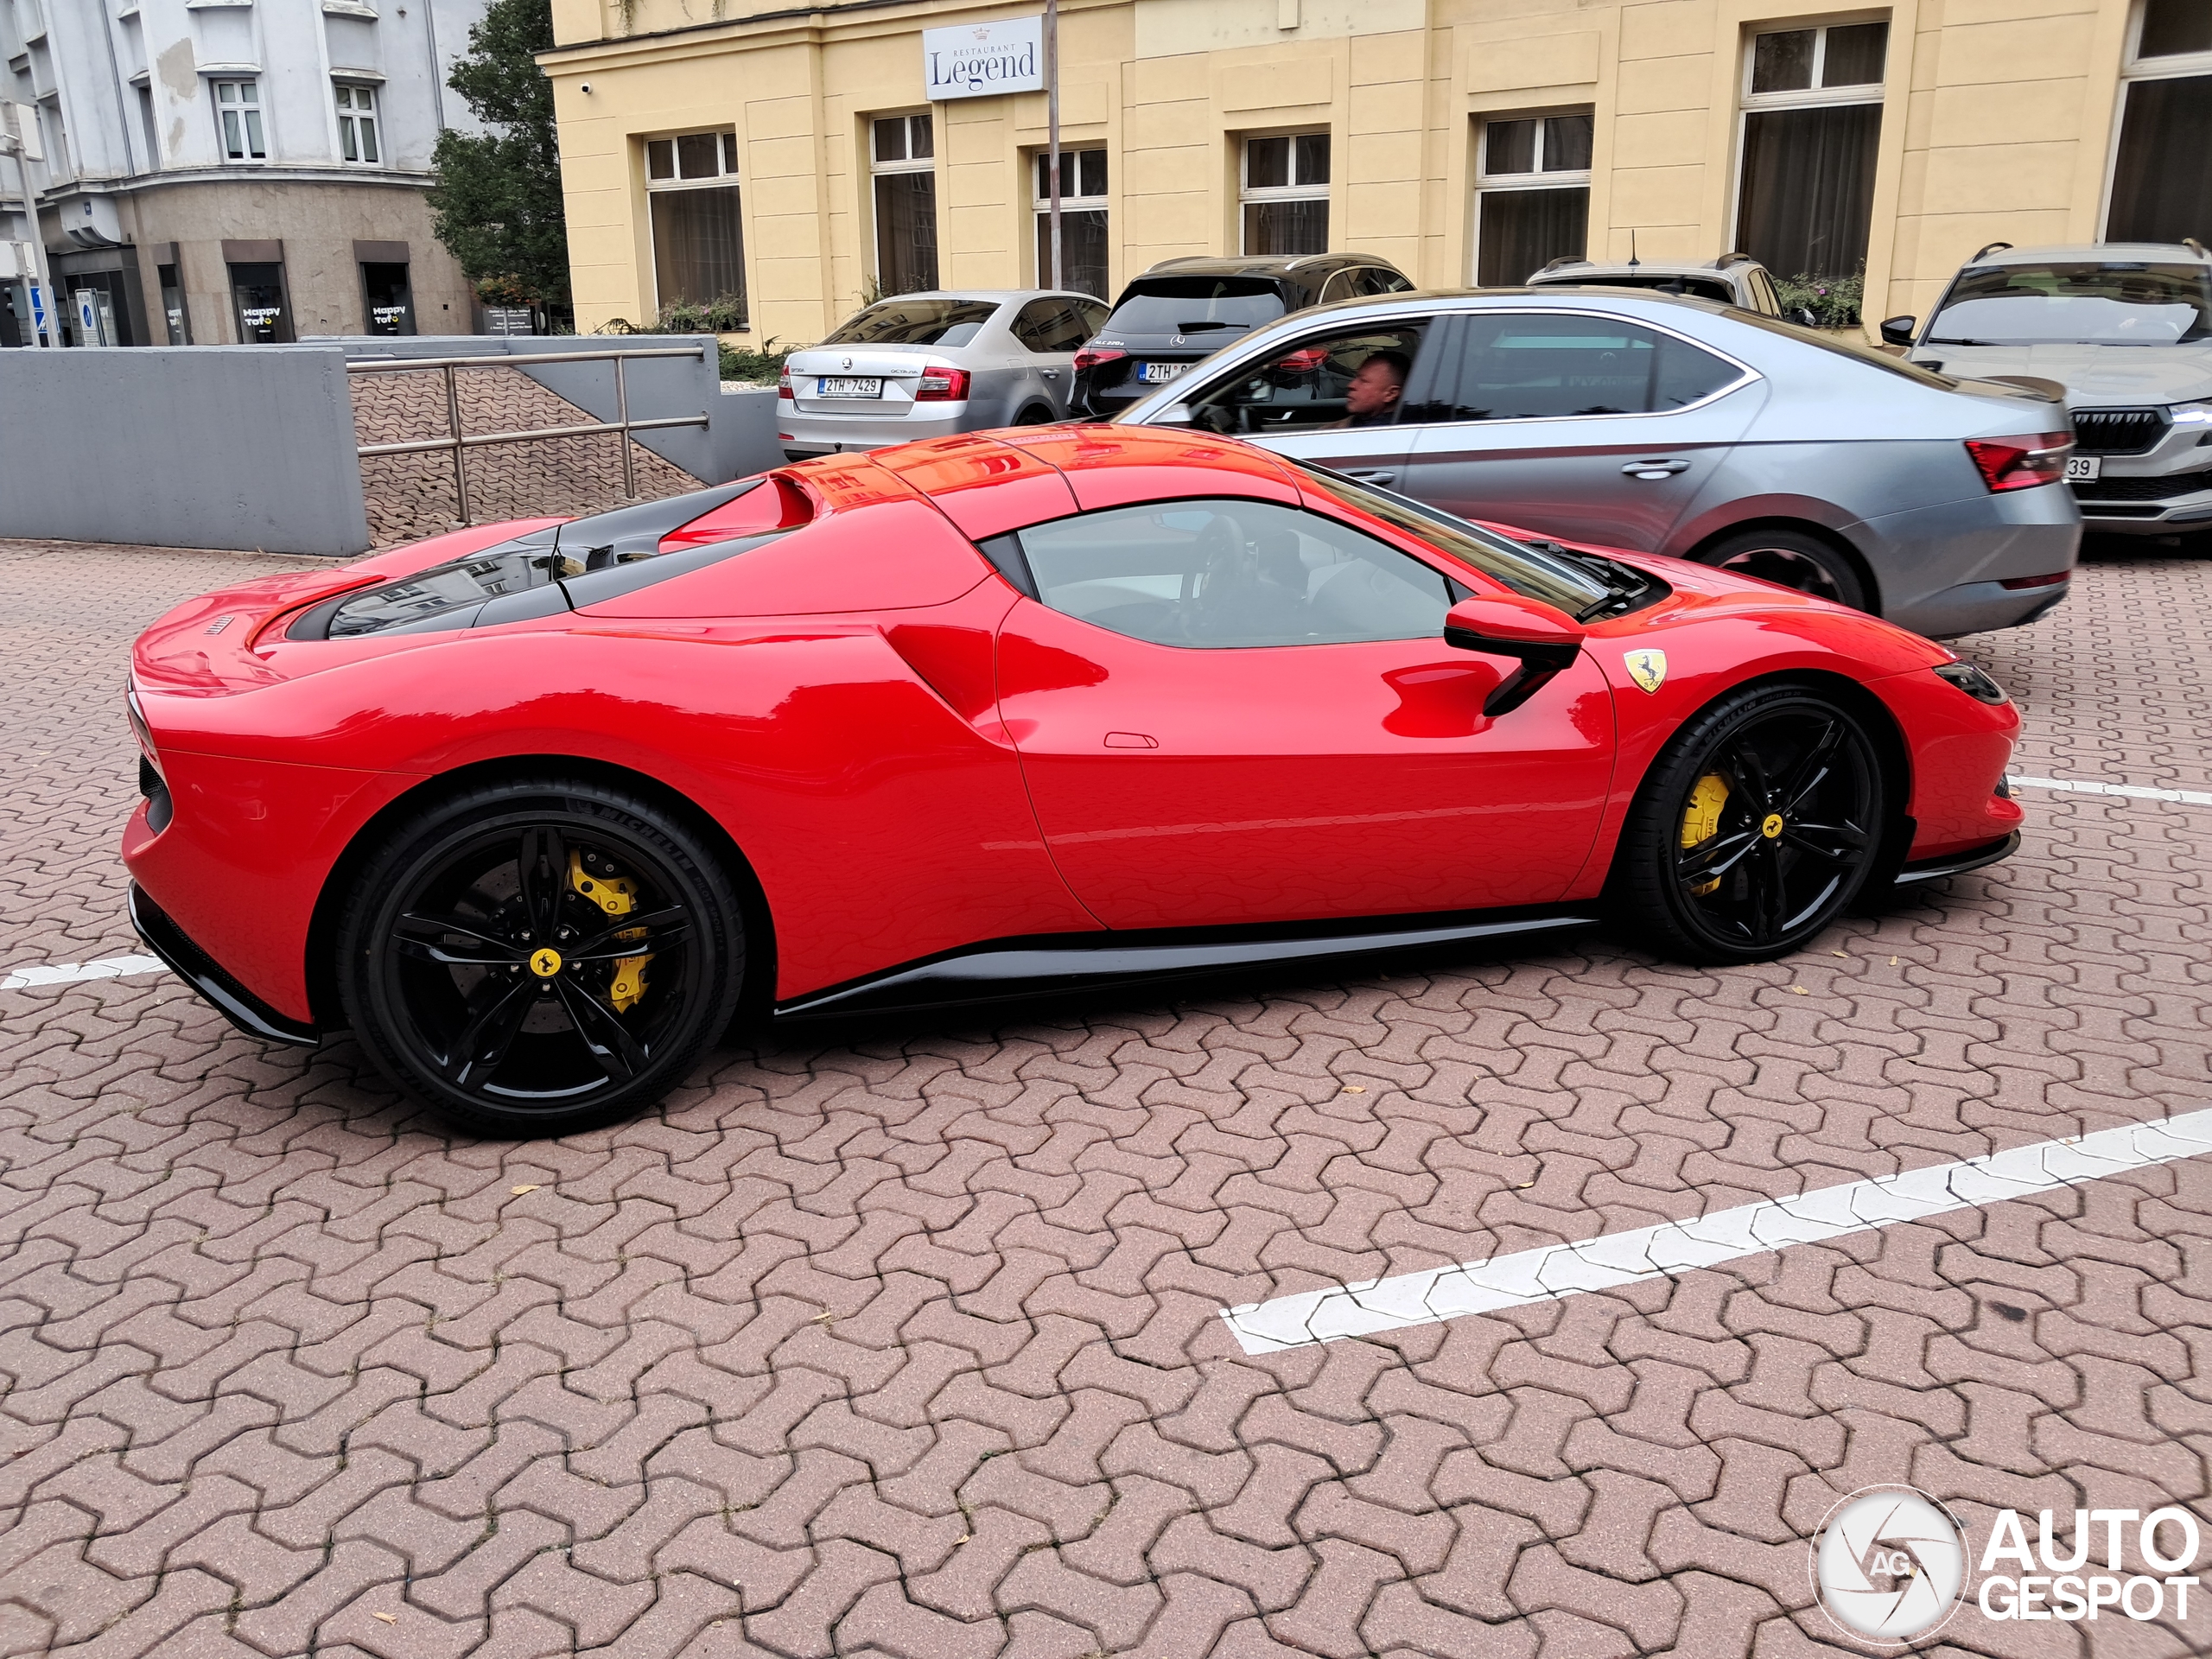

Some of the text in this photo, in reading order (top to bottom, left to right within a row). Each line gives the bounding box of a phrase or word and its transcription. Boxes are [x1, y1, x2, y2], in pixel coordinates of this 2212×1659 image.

[953, 44, 1016, 57] RESTAURANT
[929, 41, 1037, 92] Legend
[243, 308, 281, 317] Happy
[372, 306, 405, 315] Happy
[1148, 365, 1172, 378] 2TH
[827, 379, 877, 392] 2TH 7429
[2068, 459, 2090, 475] 39
[1704, 700, 1757, 745] MICHELIN
[598, 805, 695, 871] MICHELIN
[693, 876, 714, 904] PILOT
[709, 906, 724, 938] SPORT
